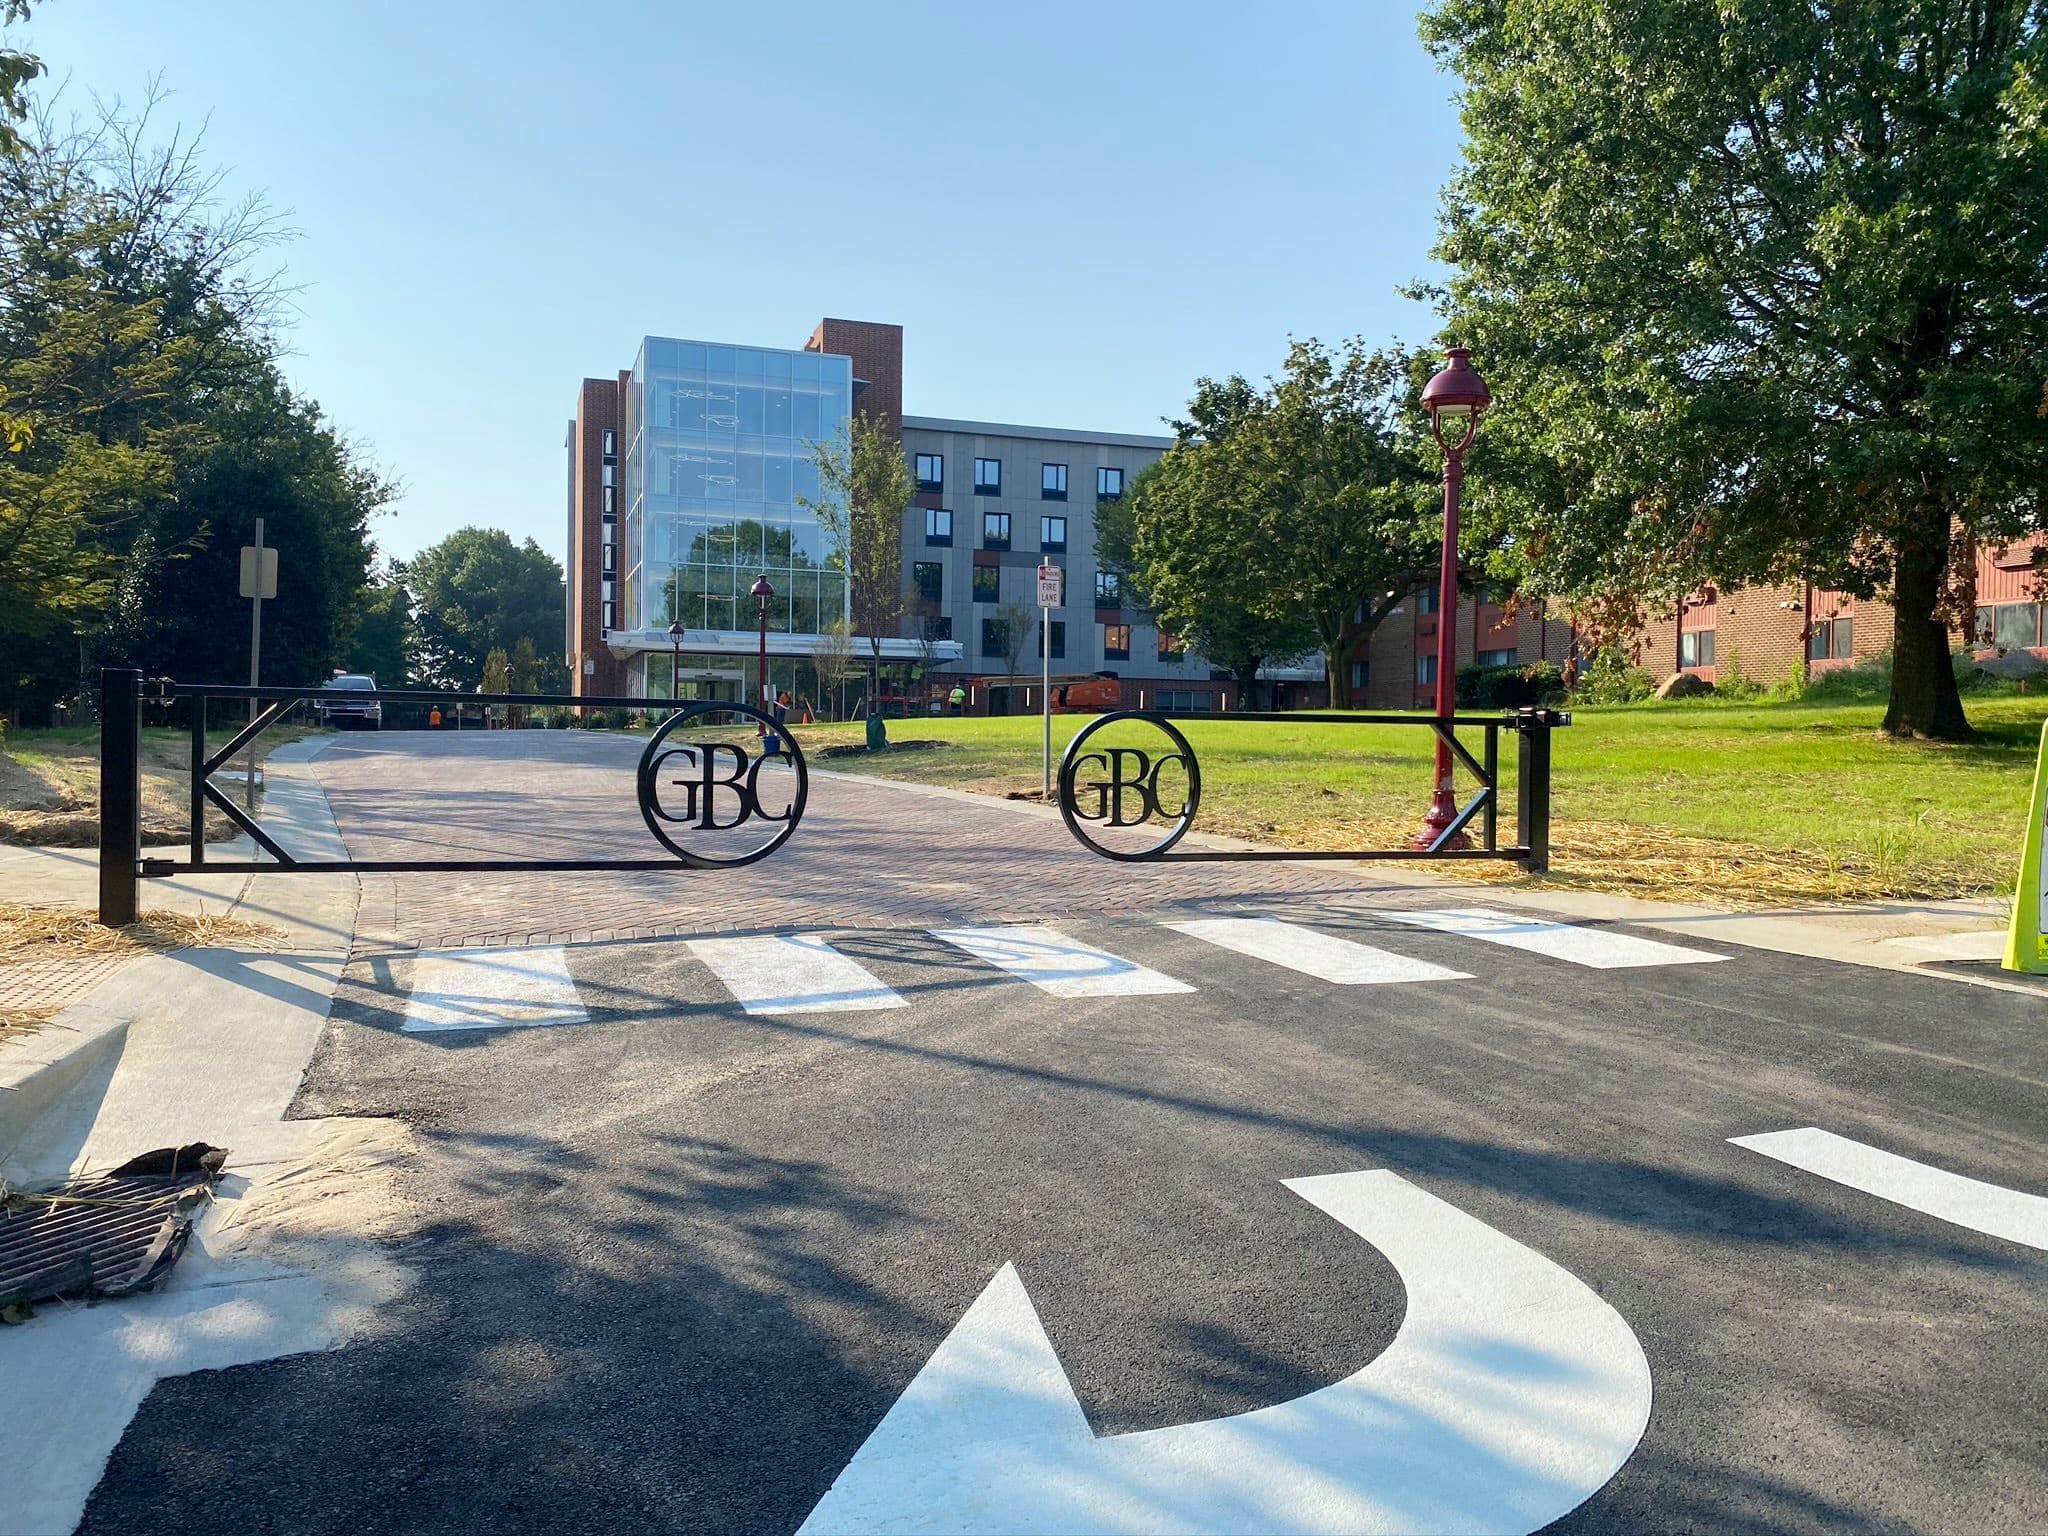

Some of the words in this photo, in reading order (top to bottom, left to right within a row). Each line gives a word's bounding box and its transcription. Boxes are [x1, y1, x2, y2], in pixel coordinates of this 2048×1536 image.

[1041, 594, 1057, 602] LANE
[1042, 583, 1057, 592] FIRE
[648, 743, 793, 830] GBC
[1068, 748, 1188, 827] GBC
